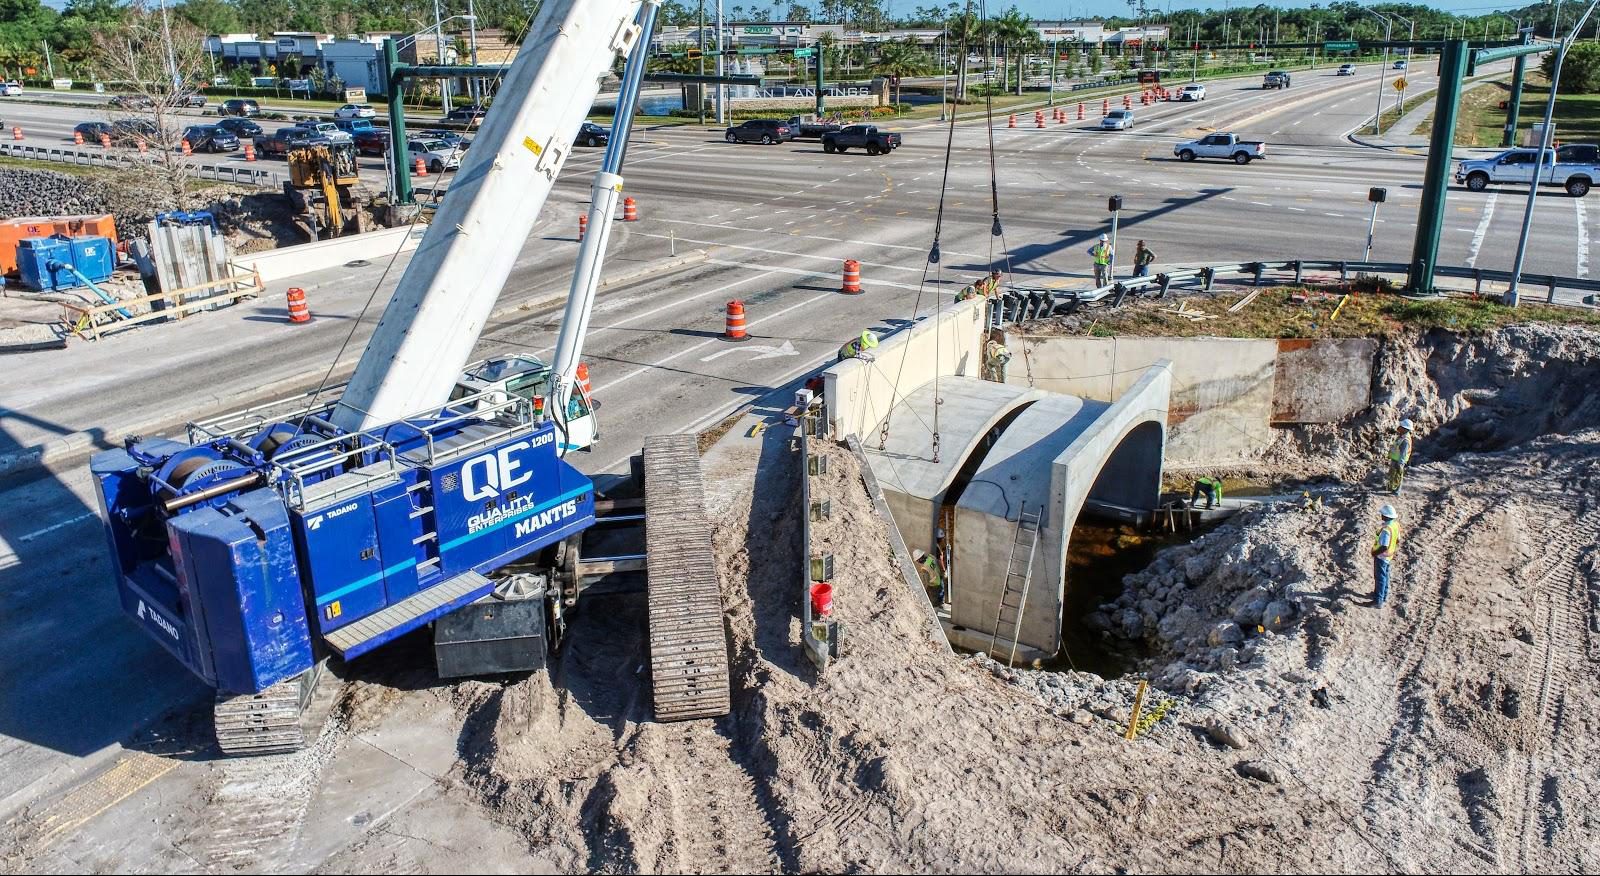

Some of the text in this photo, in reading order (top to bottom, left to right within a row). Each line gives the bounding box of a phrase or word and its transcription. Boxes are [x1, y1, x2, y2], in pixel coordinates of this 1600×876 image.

[783, 86, 869, 99] LANINGS
[531, 432, 554, 448] 1200
[461, 441, 534, 502] QE
[326, 502, 358, 519] TADANO
[467, 492, 534, 529] QUALITY
[468, 501, 535, 534] ENTERPRISES
[514, 499, 577, 539] MANTIS
[147, 606, 179, 640] TADANO
